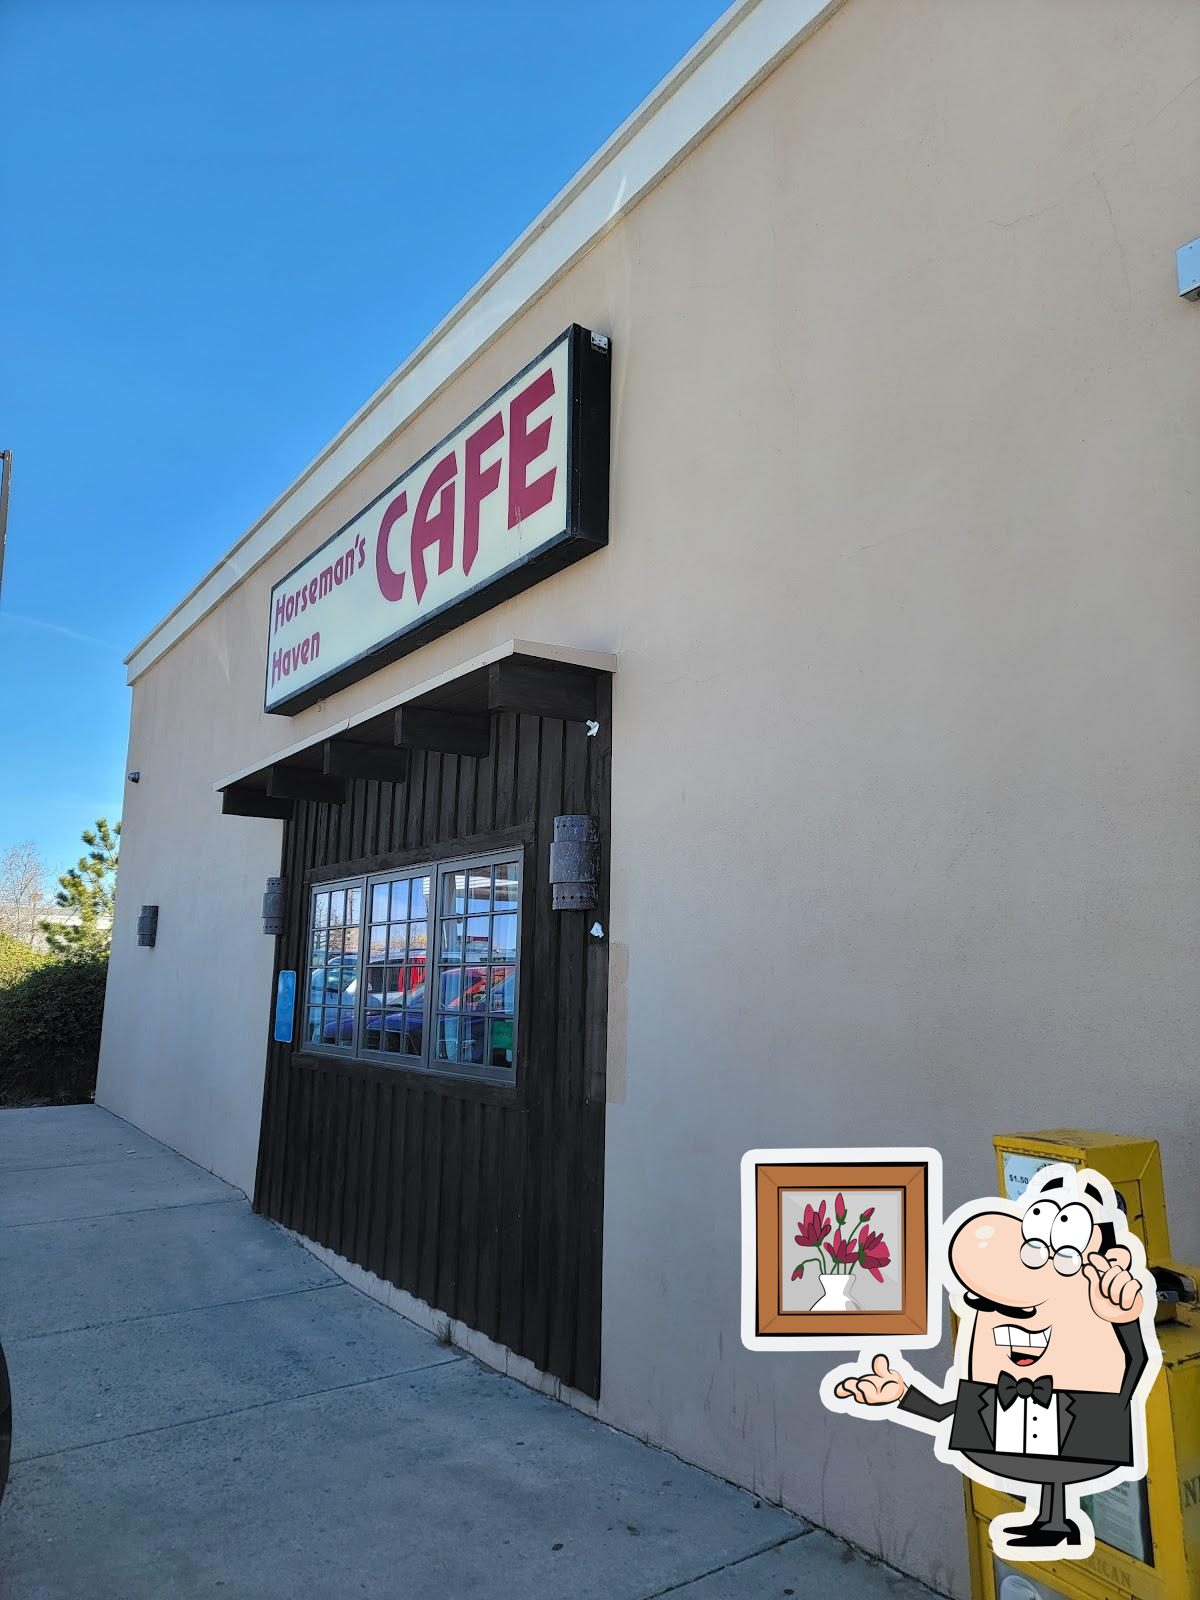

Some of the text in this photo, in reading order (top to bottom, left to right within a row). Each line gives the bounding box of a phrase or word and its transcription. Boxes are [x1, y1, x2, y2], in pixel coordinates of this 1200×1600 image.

[375, 367, 558, 606] CAFE
[274, 533, 366, 635] Horseman's
[271, 631, 321, 689] Haven
[1008, 1174, 1029, 1185] $1.50
[1182, 1475, 1200, 1508] N
